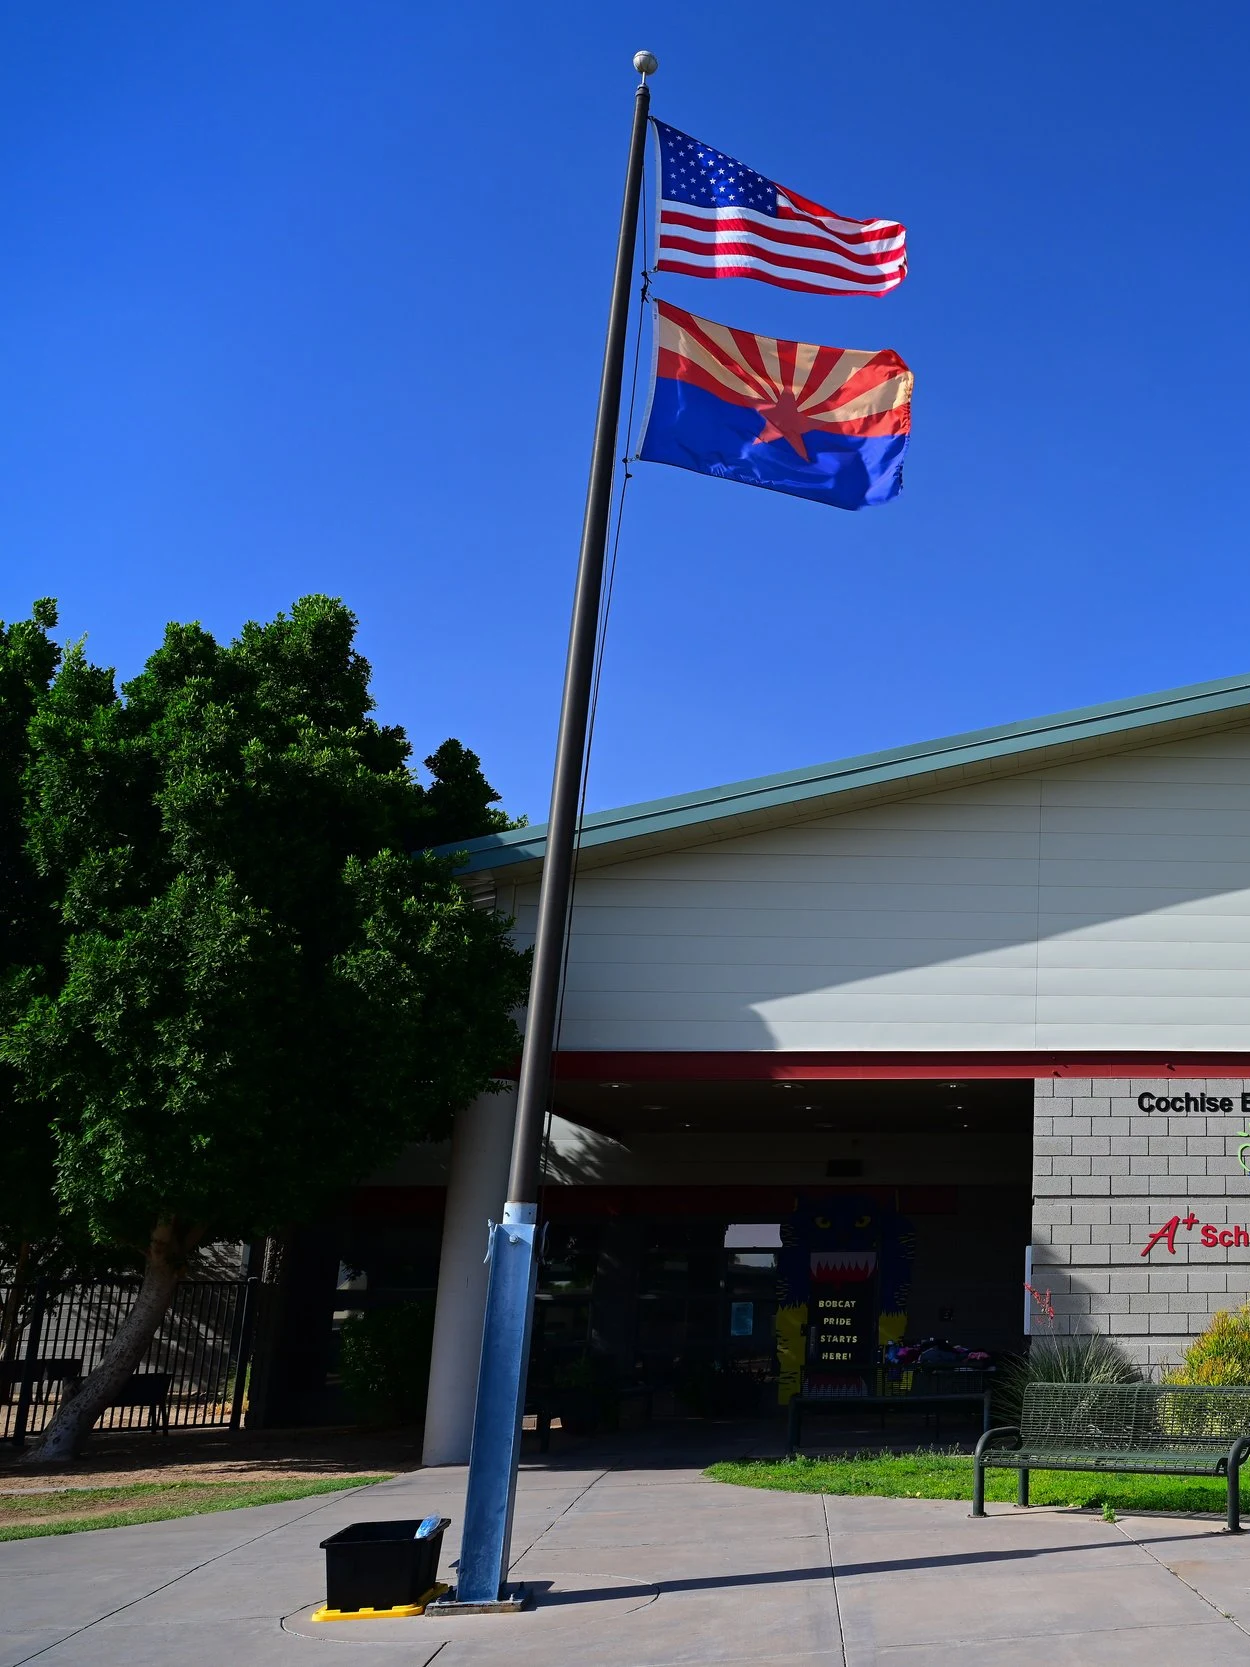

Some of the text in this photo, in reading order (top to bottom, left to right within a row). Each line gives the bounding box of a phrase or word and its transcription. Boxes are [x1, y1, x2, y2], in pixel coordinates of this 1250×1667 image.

[1138, 1092, 1234, 1113] Cochise
[1141, 1212, 1200, 1257] A+
[818, 1300, 857, 1308] BOBCAT
[823, 1317, 852, 1326] PRIDE
[820, 1335, 858, 1343] STARTS
